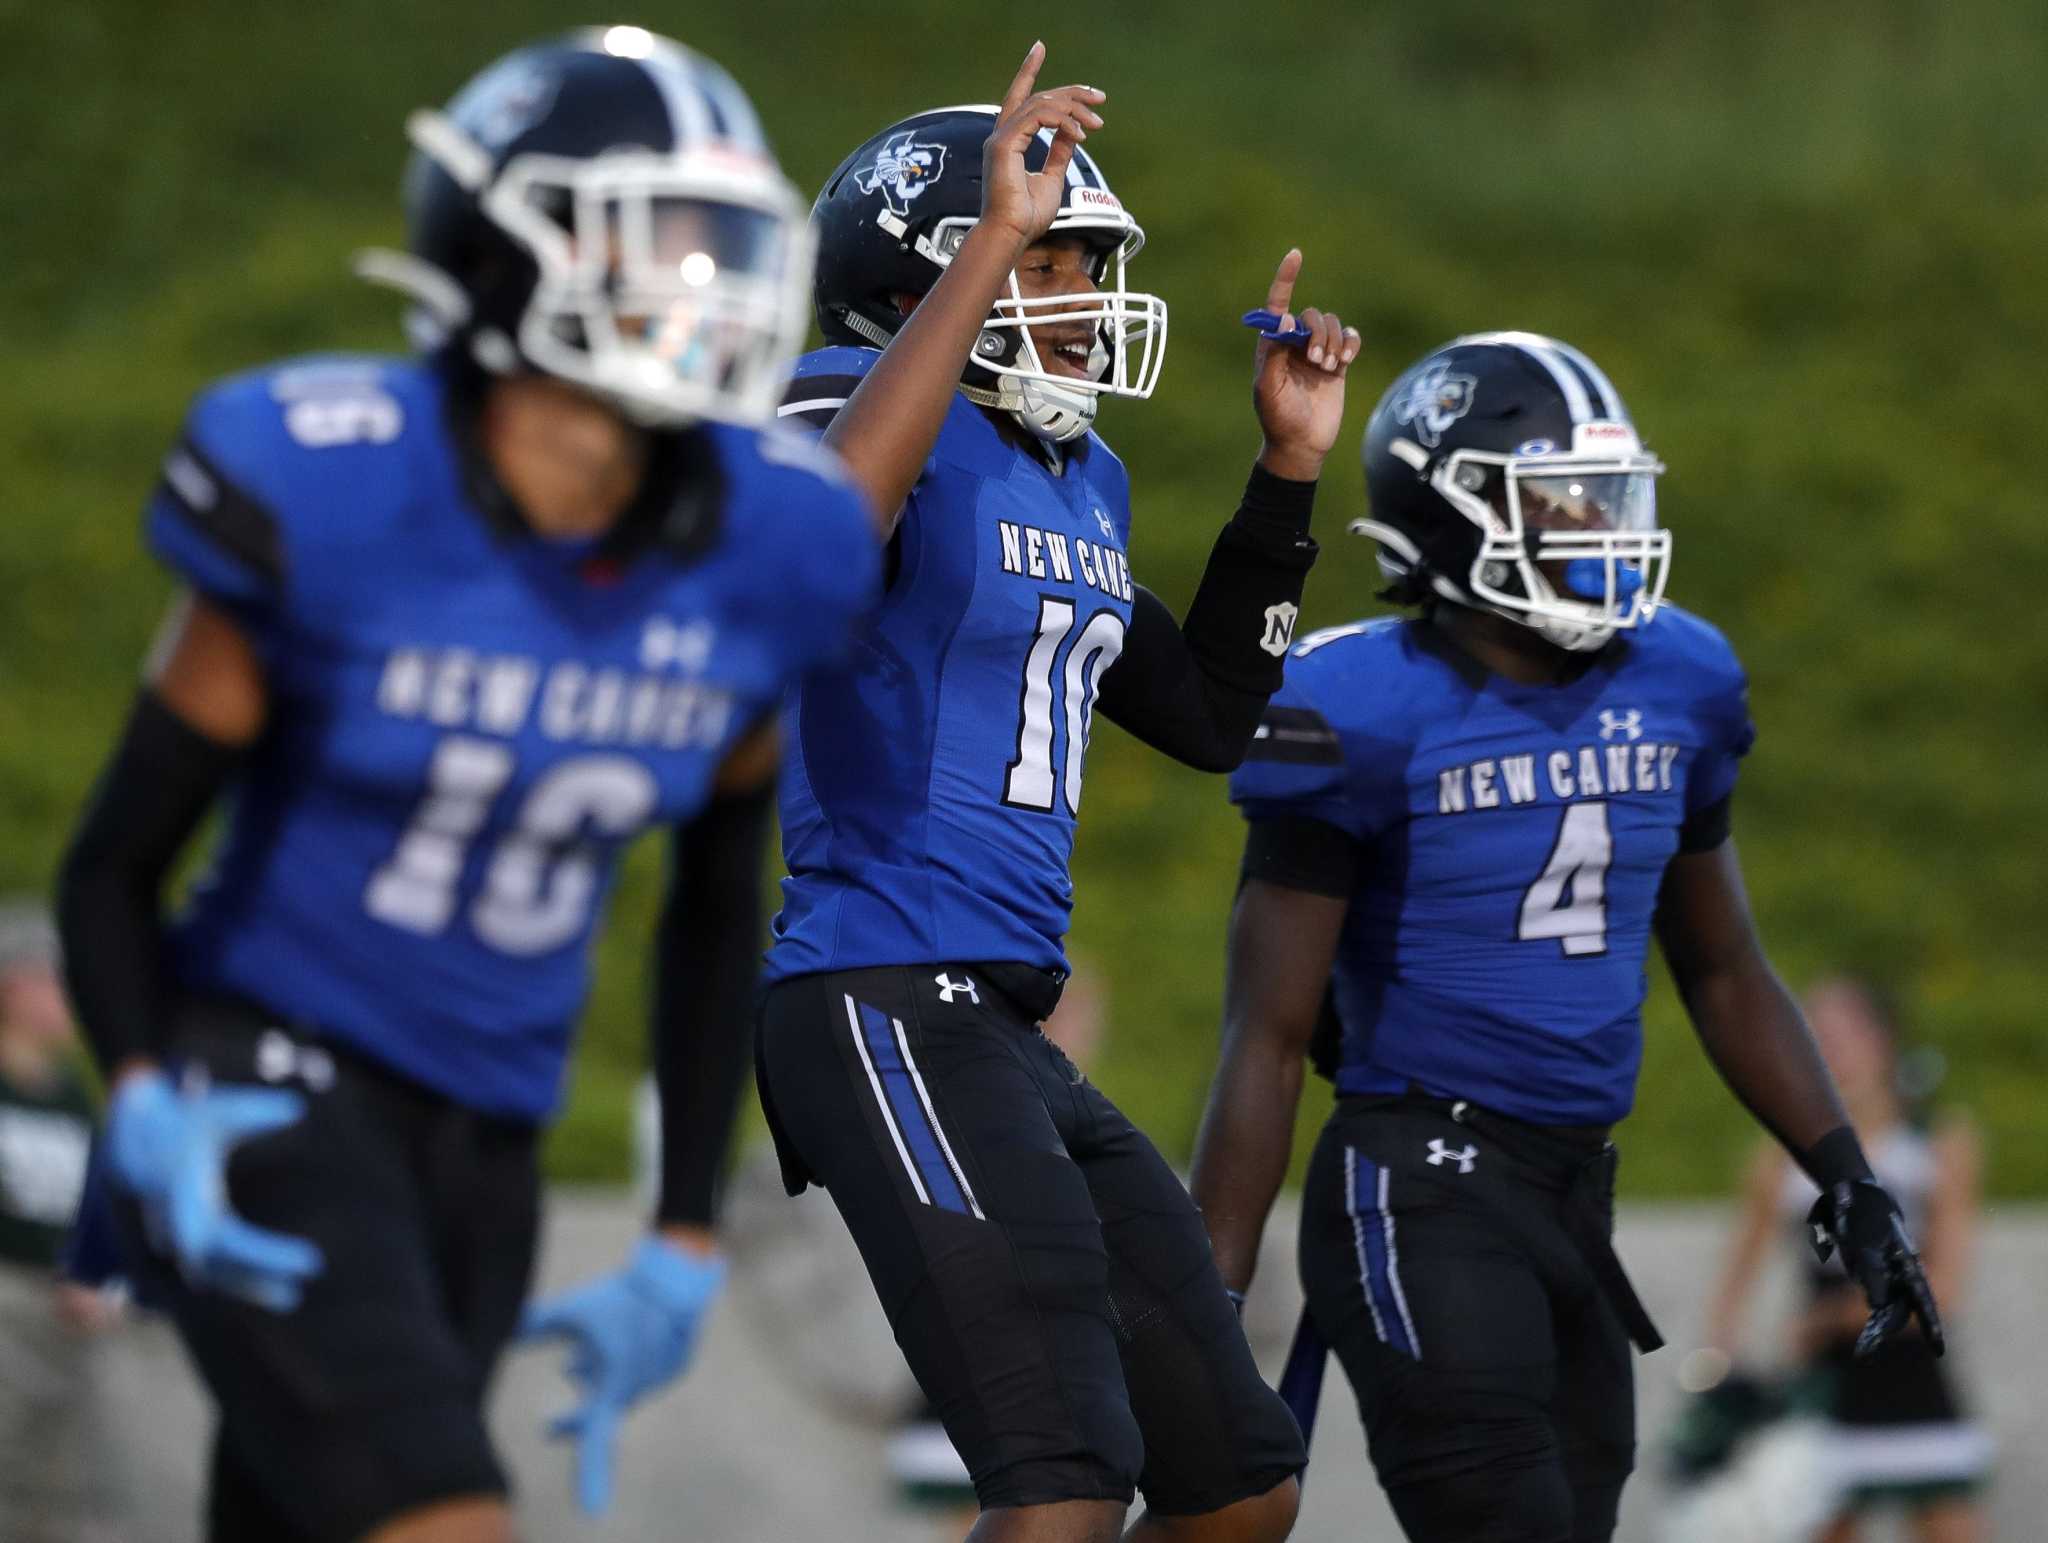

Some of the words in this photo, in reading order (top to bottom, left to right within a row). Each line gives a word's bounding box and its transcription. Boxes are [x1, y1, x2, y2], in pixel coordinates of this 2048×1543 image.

[999, 520, 1074, 584] NEW
[1267, 613, 1295, 645] N
[376, 645, 540, 738] NEW
[1000, 593, 1125, 820] 10
[1438, 753, 1537, 815] NEW
[1547, 742, 1680, 799] CANEY
[1516, 799, 1612, 958] 4
